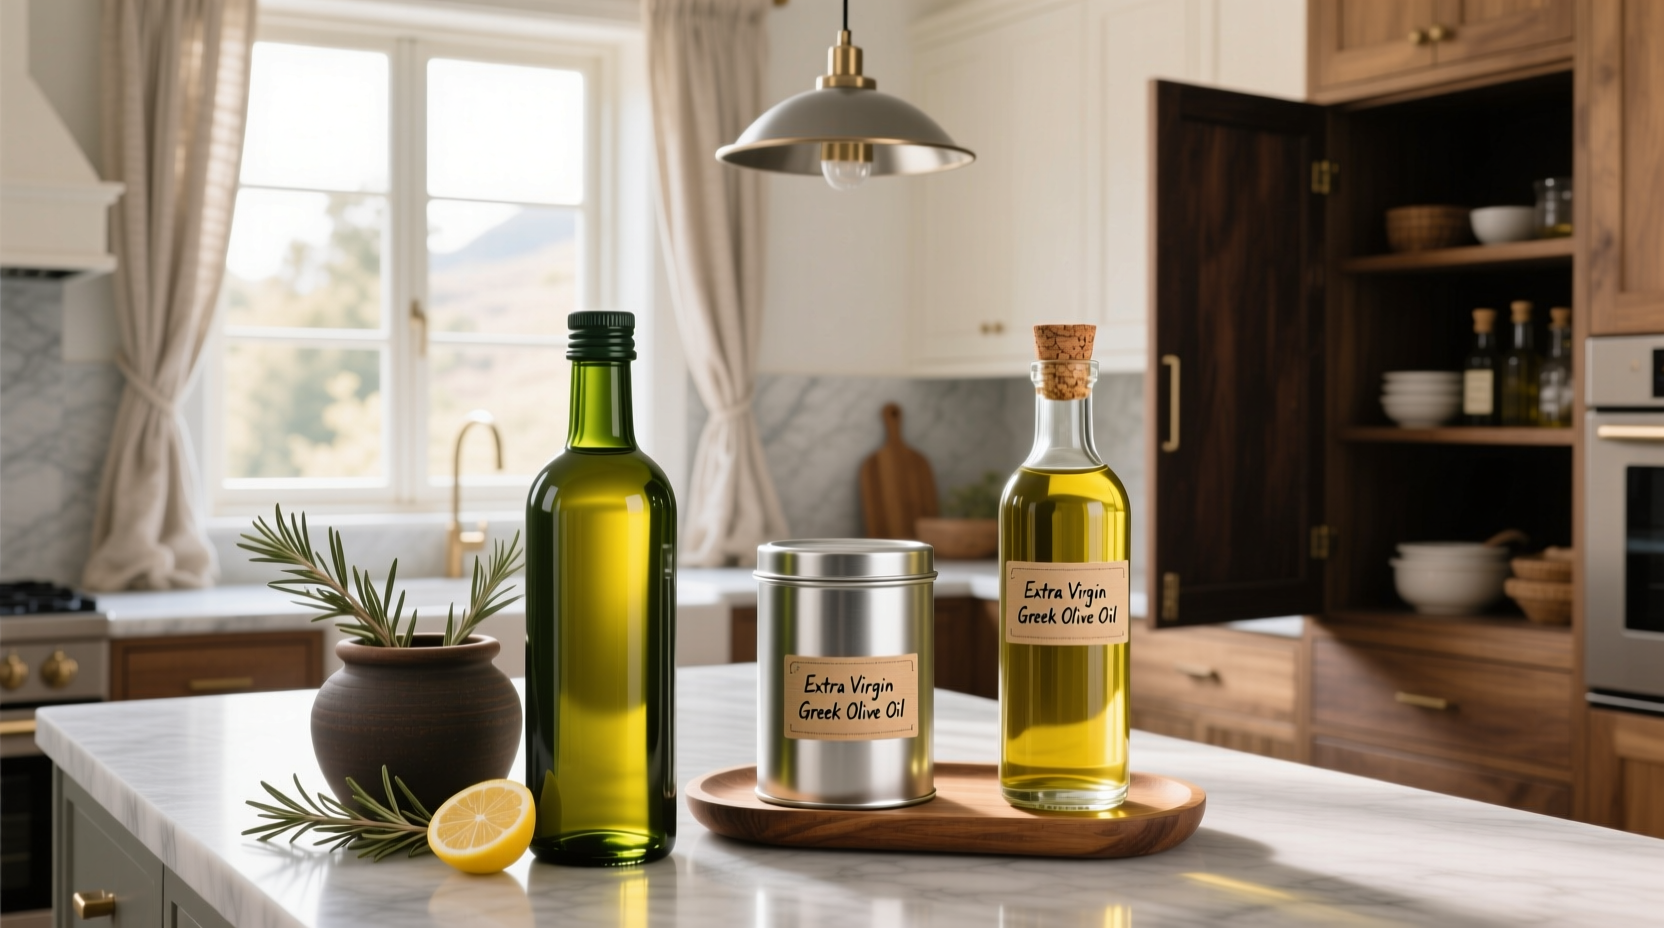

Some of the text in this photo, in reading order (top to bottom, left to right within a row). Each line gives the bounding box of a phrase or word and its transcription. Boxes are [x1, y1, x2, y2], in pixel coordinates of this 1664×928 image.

[1024, 580, 1107, 608] Extra Virgin
[1018, 605, 1117, 625] Greek Olive Oil
[804, 674, 894, 701] Extra Virgin
[798, 698, 905, 720] Greek Olive Oil
